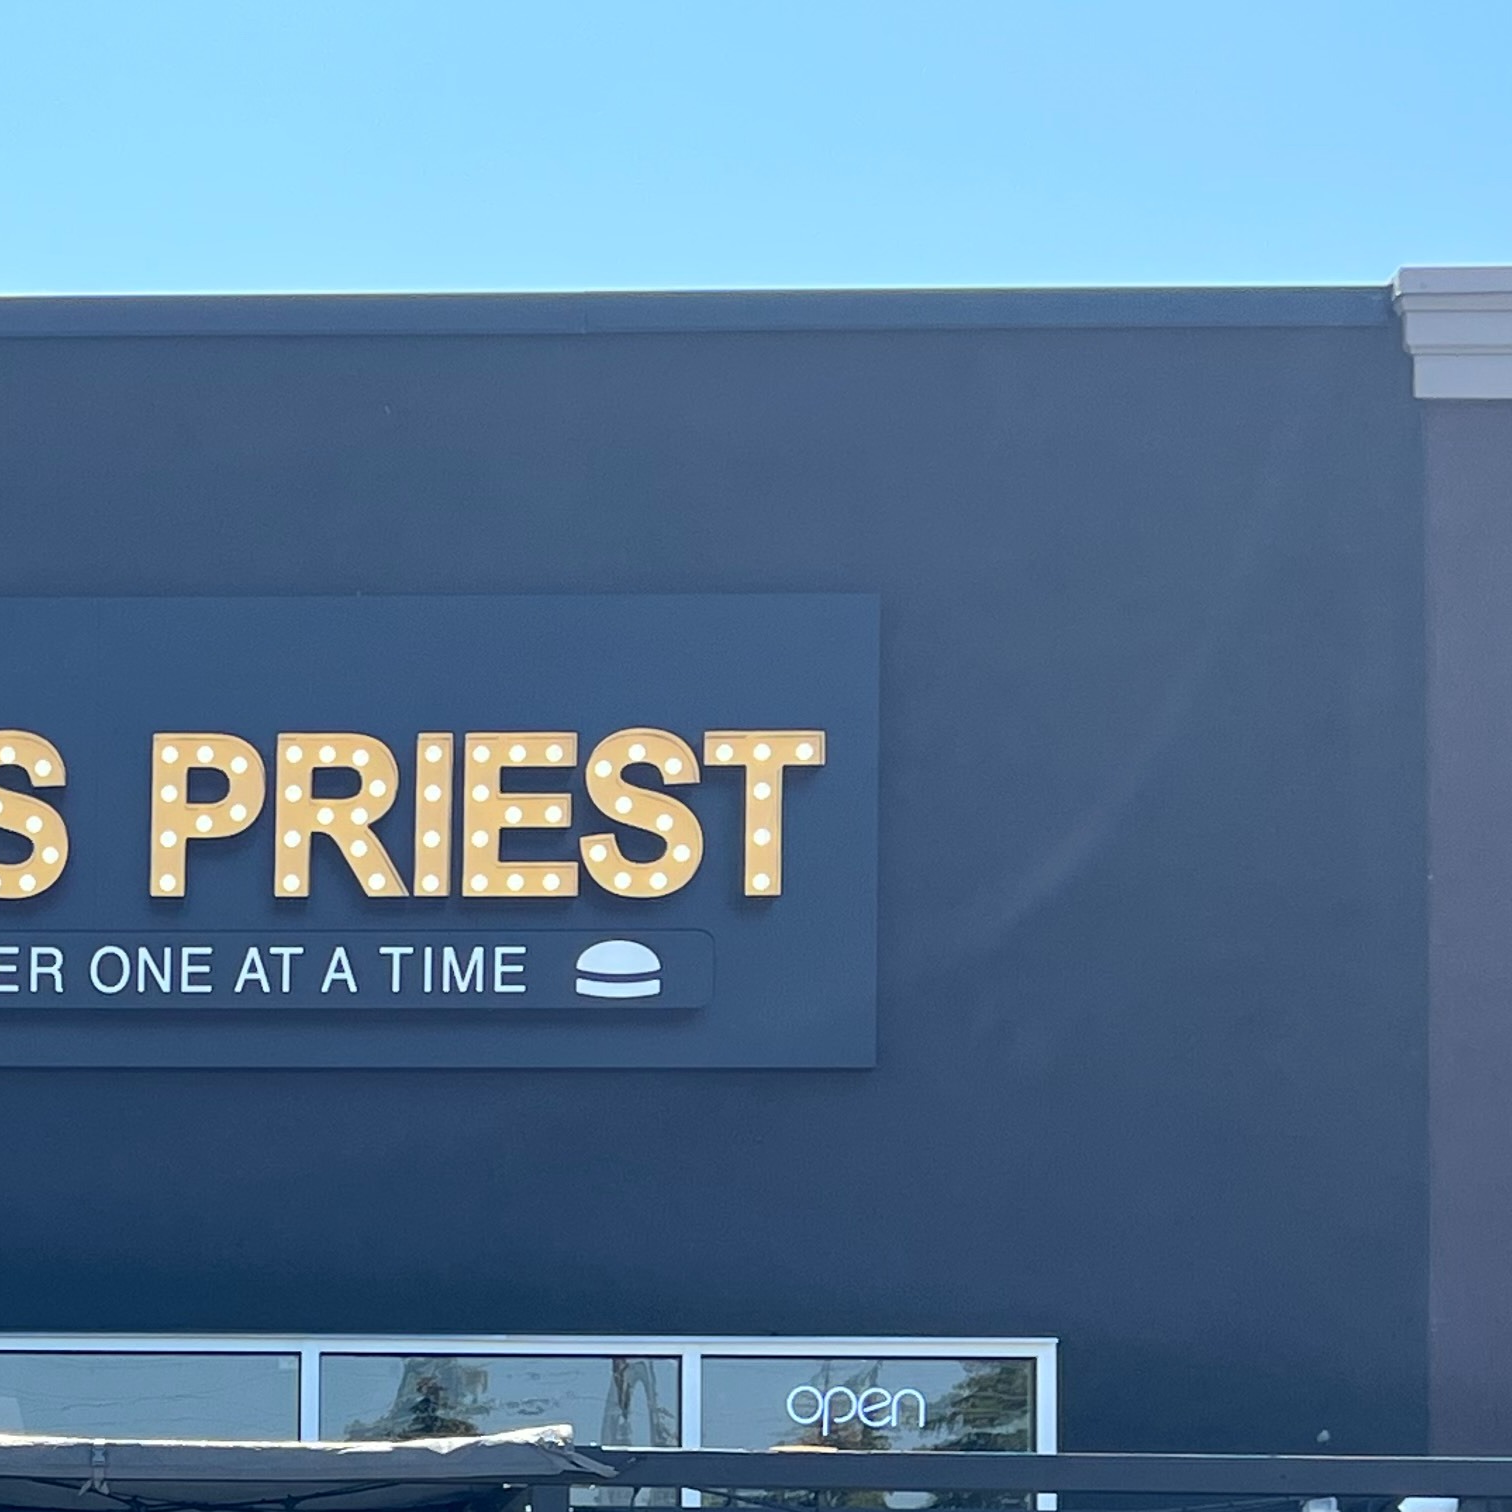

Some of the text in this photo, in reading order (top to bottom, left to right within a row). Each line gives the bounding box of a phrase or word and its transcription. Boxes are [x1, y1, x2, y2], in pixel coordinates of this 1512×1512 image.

[149, 727, 826, 898] PRIEST
[89, 944, 214, 994] ONE
[233, 946, 305, 994] AT
[320, 946, 358, 994] A
[378, 945, 527, 994] TIME
[786, 1385, 926, 1437] open
